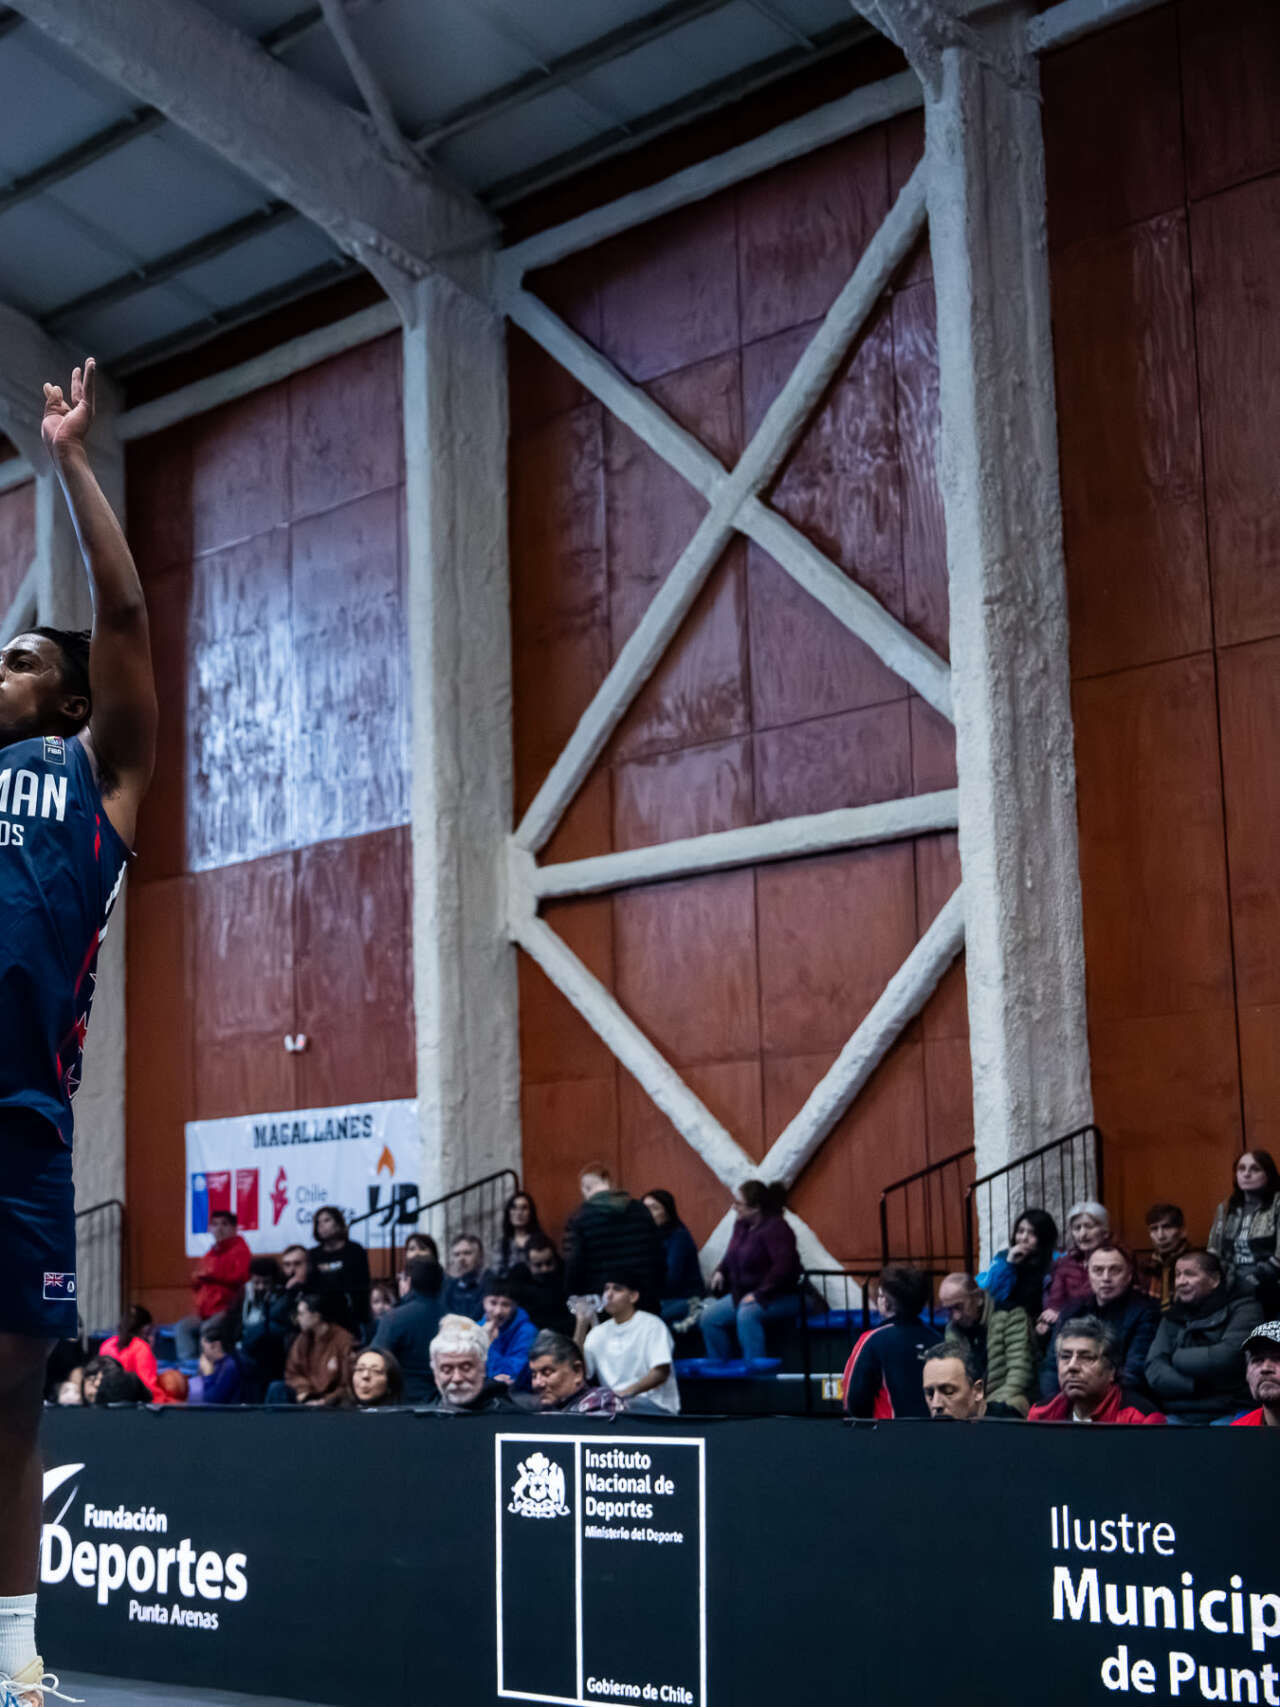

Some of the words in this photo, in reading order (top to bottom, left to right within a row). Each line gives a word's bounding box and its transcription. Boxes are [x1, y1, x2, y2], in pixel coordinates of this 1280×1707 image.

[253, 1114, 373, 1149] MAGALLANES
[295, 1183, 329, 1203] Chile
[585, 1448, 652, 1471] Instituto
[585, 1474, 652, 1495] Nacional
[654, 1475, 675, 1496] de
[84, 1503, 168, 1533] Fundación
[585, 1496, 654, 1521] Deportes
[585, 1525, 630, 1540] Ministerio
[631, 1527, 646, 1541] del
[647, 1528, 684, 1545] Deporte
[1050, 1504, 1176, 1556] Ilustre
[40, 1523, 248, 1606] Deportes
[129, 1599, 169, 1625] Punta
[169, 1603, 219, 1631] Arenas
[1052, 1566, 1280, 1652] Municip
[1100, 1644, 1157, 1694] de
[586, 1676, 642, 1699] Gobierno
[642, 1683, 658, 1702] de
[659, 1684, 694, 1705] Chile
